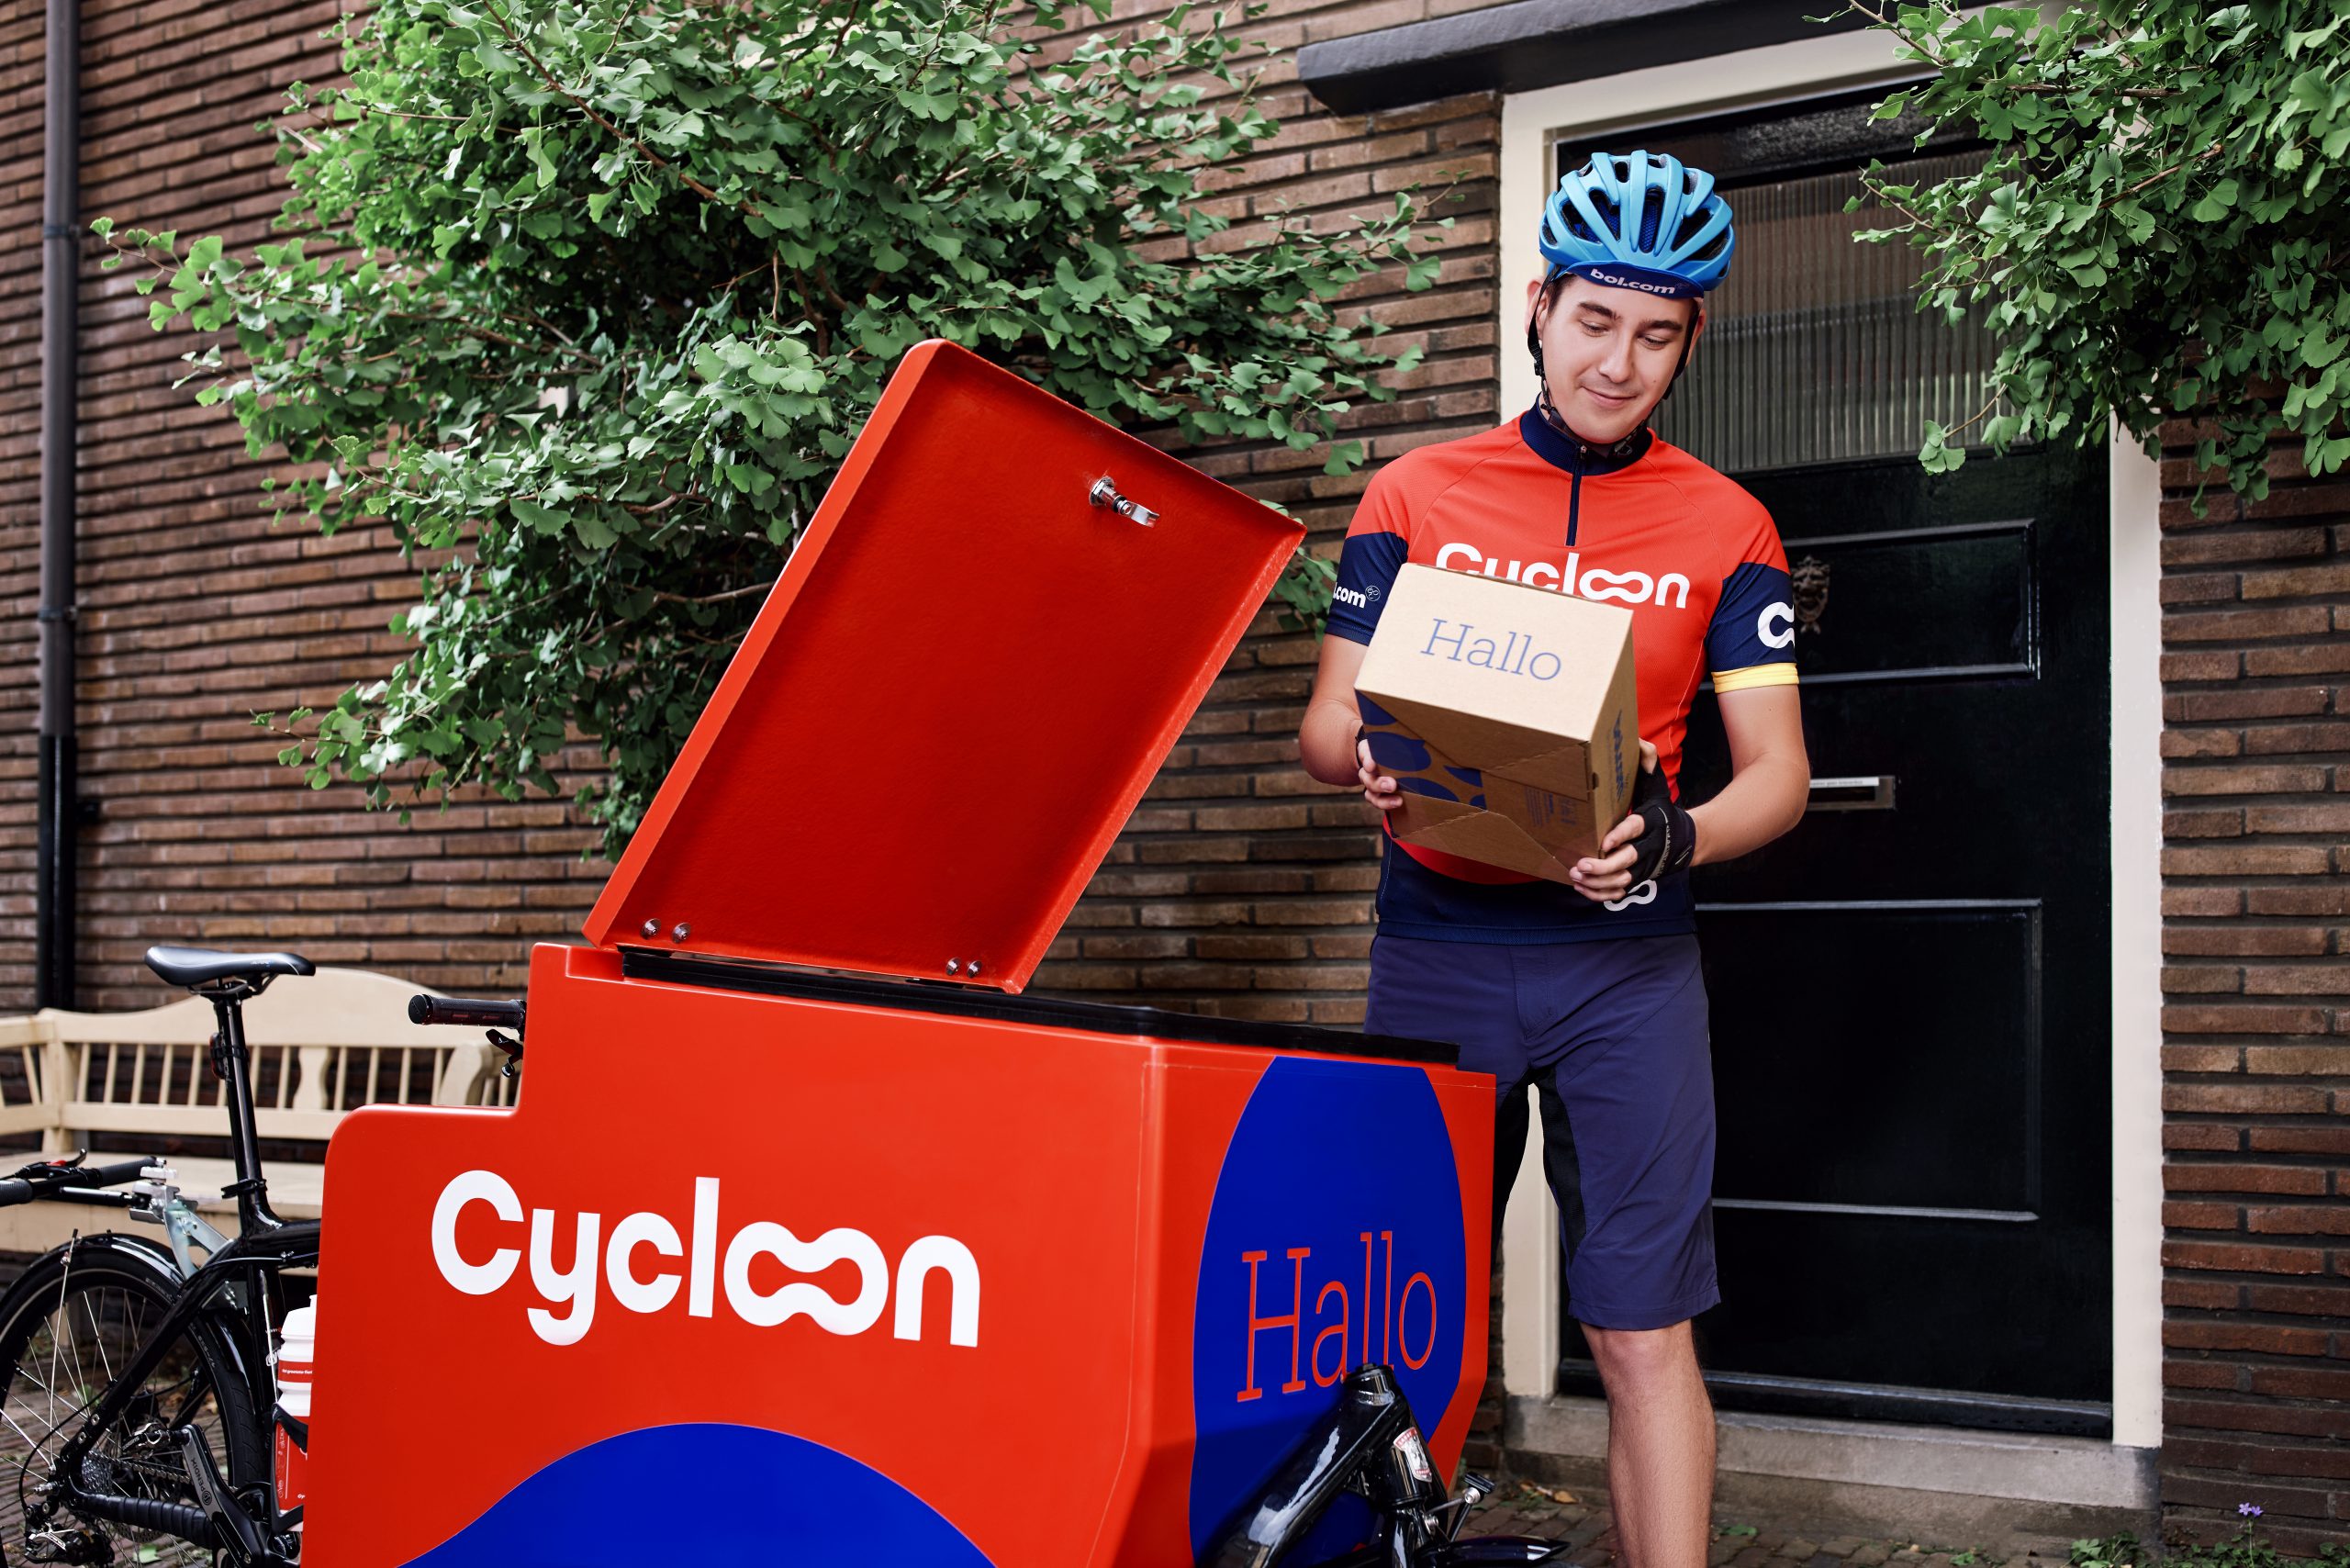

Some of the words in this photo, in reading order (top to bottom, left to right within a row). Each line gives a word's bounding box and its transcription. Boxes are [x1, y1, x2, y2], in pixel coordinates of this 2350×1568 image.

[1590, 268, 1676, 295] bol.com
[1420, 619, 1561, 681] Hallo
[431, 1170, 980, 1348] Cycloon
[1237, 1230, 1438, 1403] Hallo
[191, 1458, 206, 1492] PENDIX
